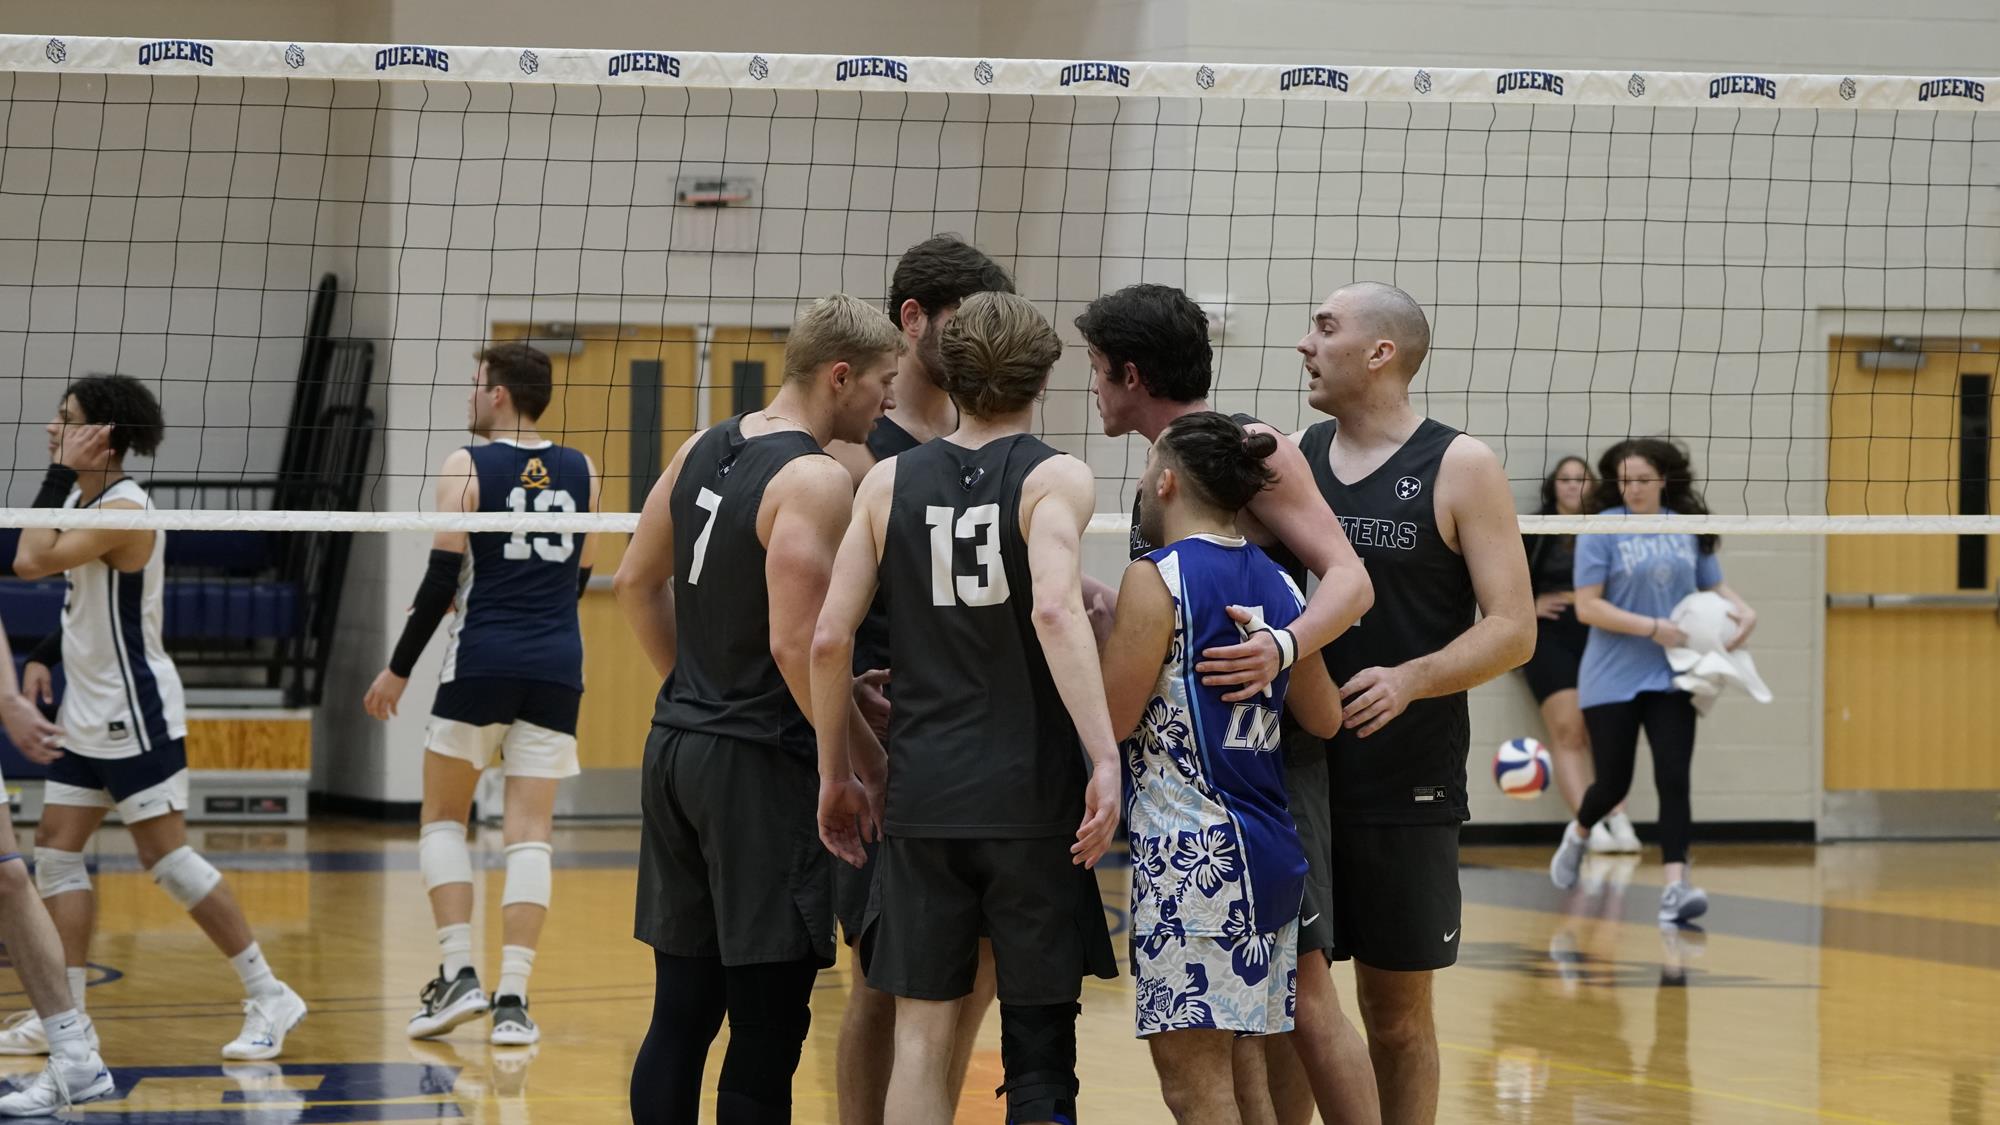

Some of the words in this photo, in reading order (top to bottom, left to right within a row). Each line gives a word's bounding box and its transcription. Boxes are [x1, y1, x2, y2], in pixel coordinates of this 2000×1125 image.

[138, 39, 214, 66] QUEENS
[375, 45, 449, 72] QUEENS
[608, 50, 681, 77] QUEENS
[836, 55, 908, 82] QUEENS
[1059, 61, 1131, 87] QUEENS
[1280, 66, 1349, 91] QUEENS
[1496, 70, 1564, 94] QUEENS
[1709, 74, 1777, 97] QUEENS
[1918, 77, 1985, 99] QUEENS
[688, 486, 723, 586] 7
[1336, 516, 1418, 550] TERS
[925, 502, 1011, 607] 13
